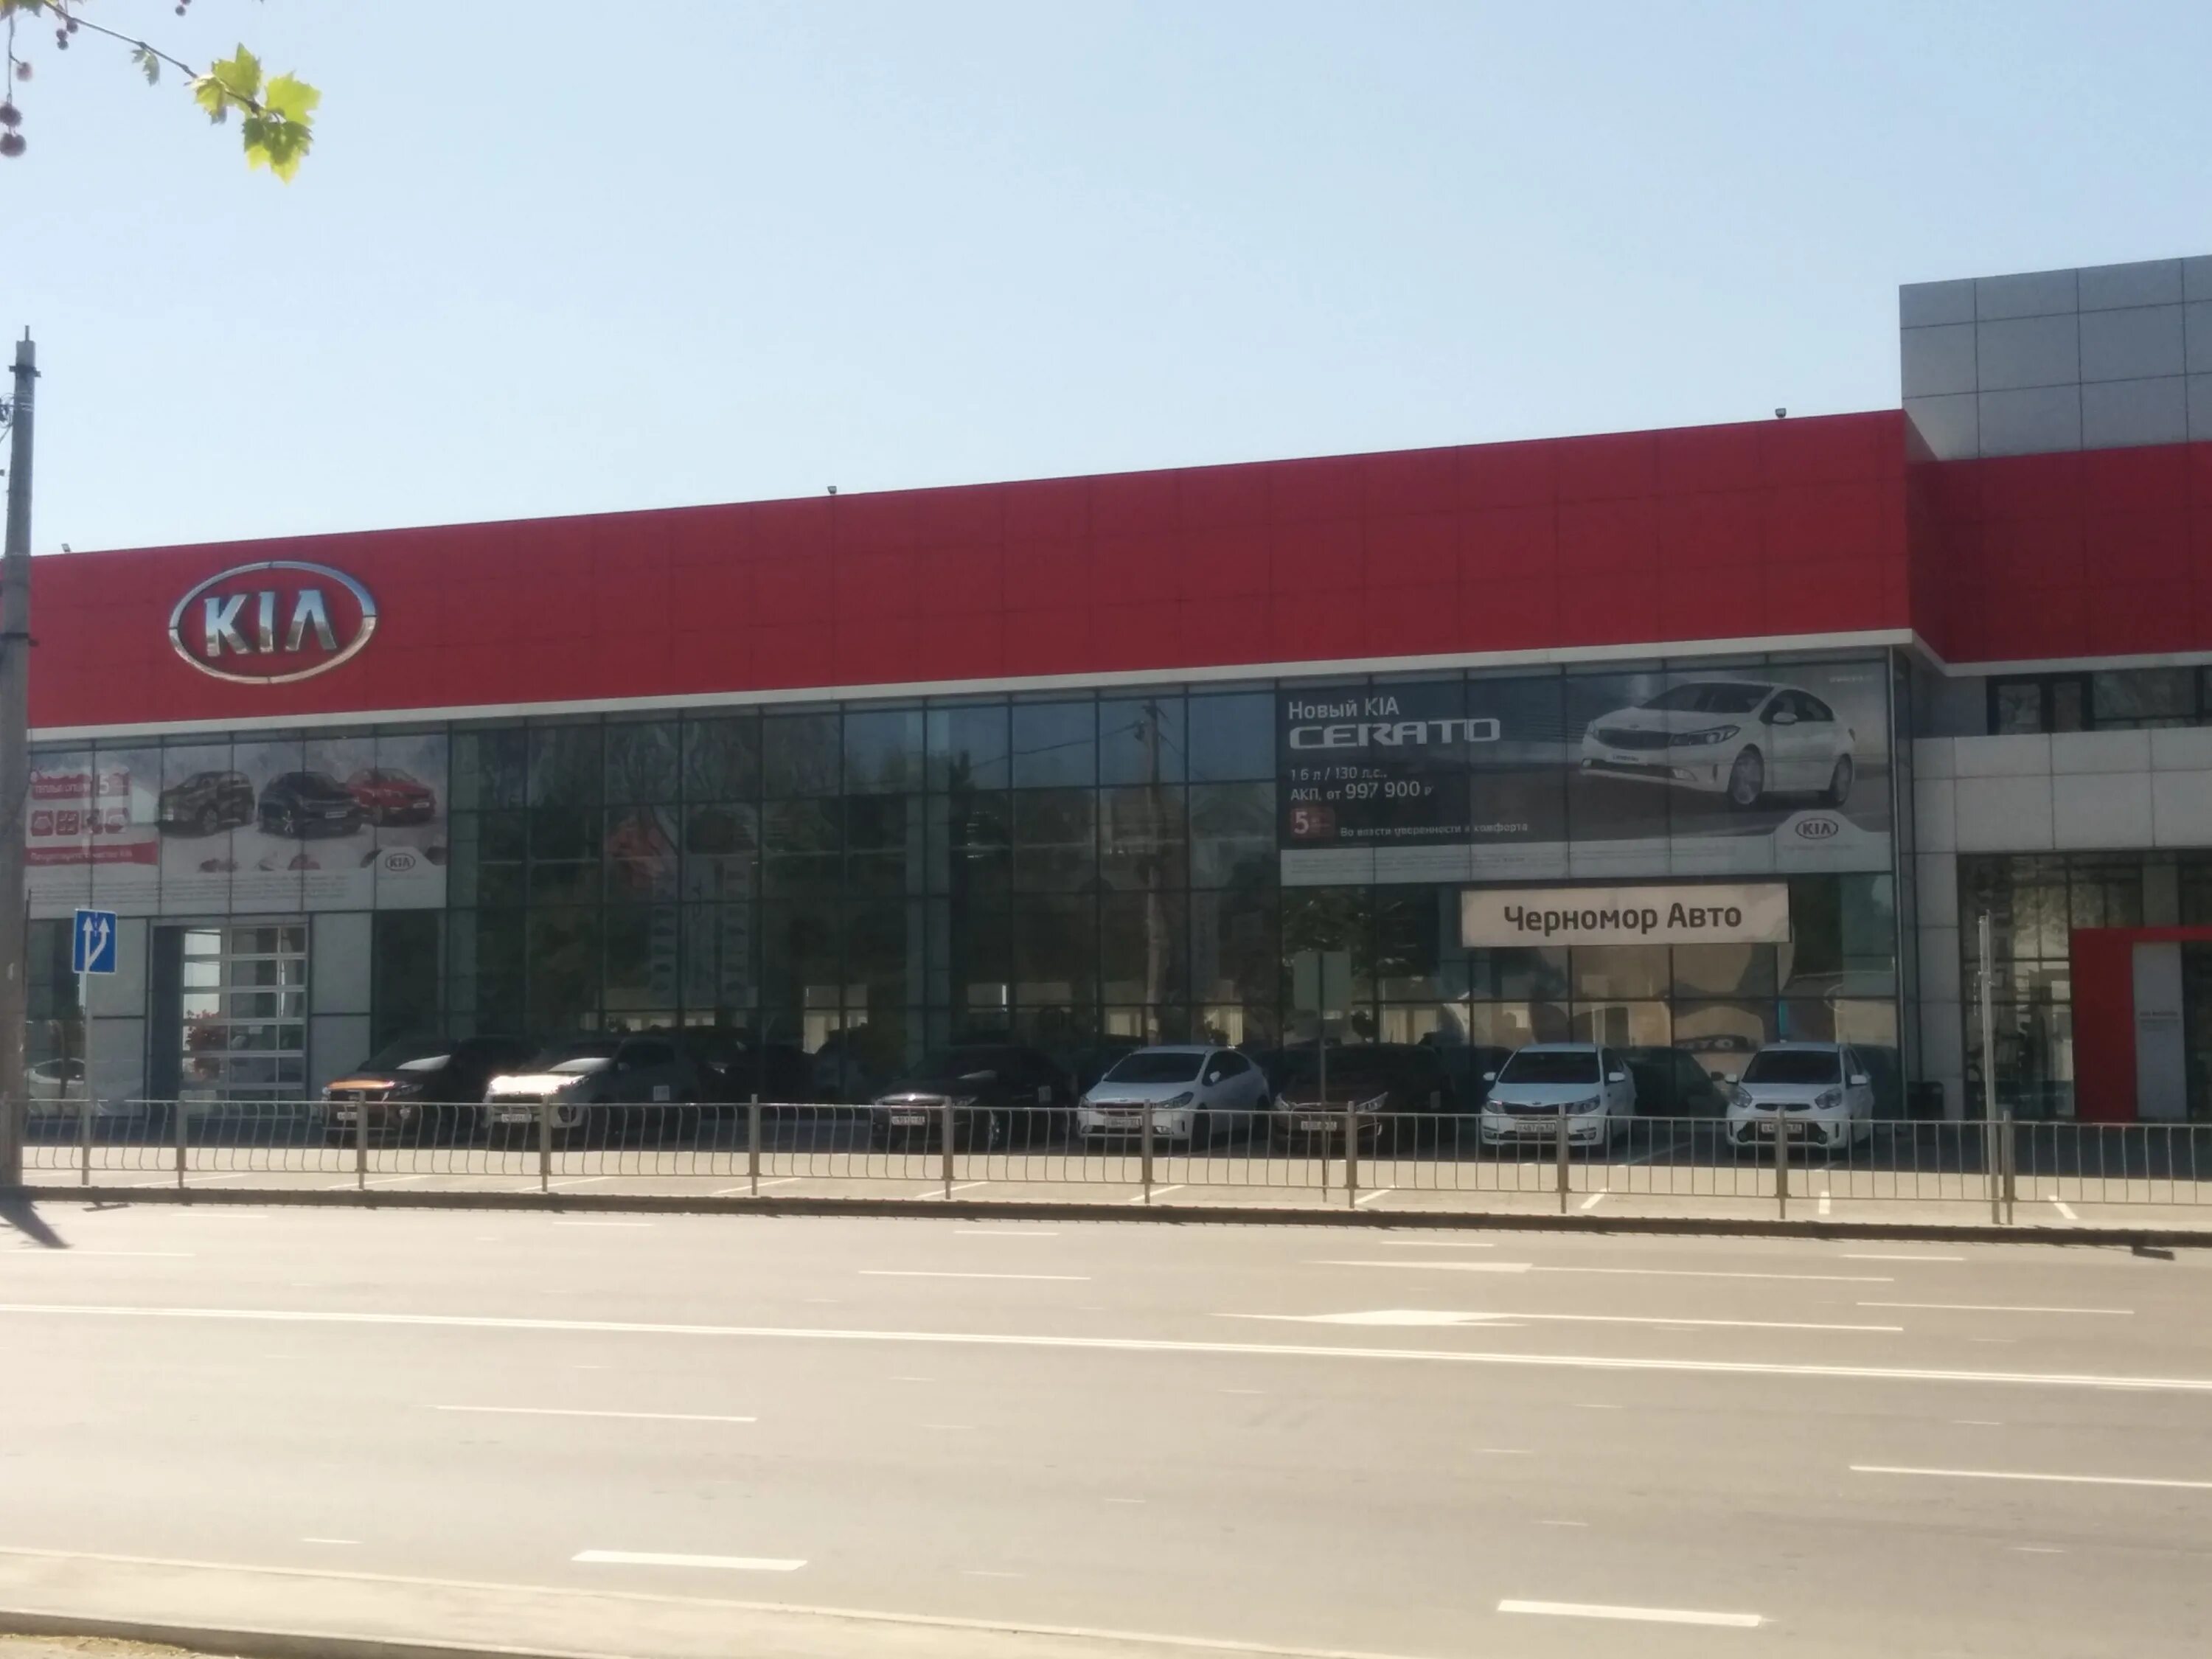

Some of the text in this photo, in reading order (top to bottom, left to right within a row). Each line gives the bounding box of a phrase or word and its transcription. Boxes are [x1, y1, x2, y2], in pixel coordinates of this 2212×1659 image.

[204, 589, 338, 657] KIA
[1288, 697, 1400, 720] Новый KIA
[1289, 718, 1501, 750] CERATO
[1335, 767, 1357, 779] 130
[100, 775, 110, 794] 5
[1345, 782, 1379, 799] 997
[1384, 781, 1421, 798] 900
[1293, 811, 1310, 835] 5
[1340, 827, 1354, 837] Во
[1473, 822, 1528, 835] комфорта
[1802, 823, 1832, 835] KIA
[389, 857, 411, 868] KIA
[1503, 902, 1742, 937] Черномор Авто
